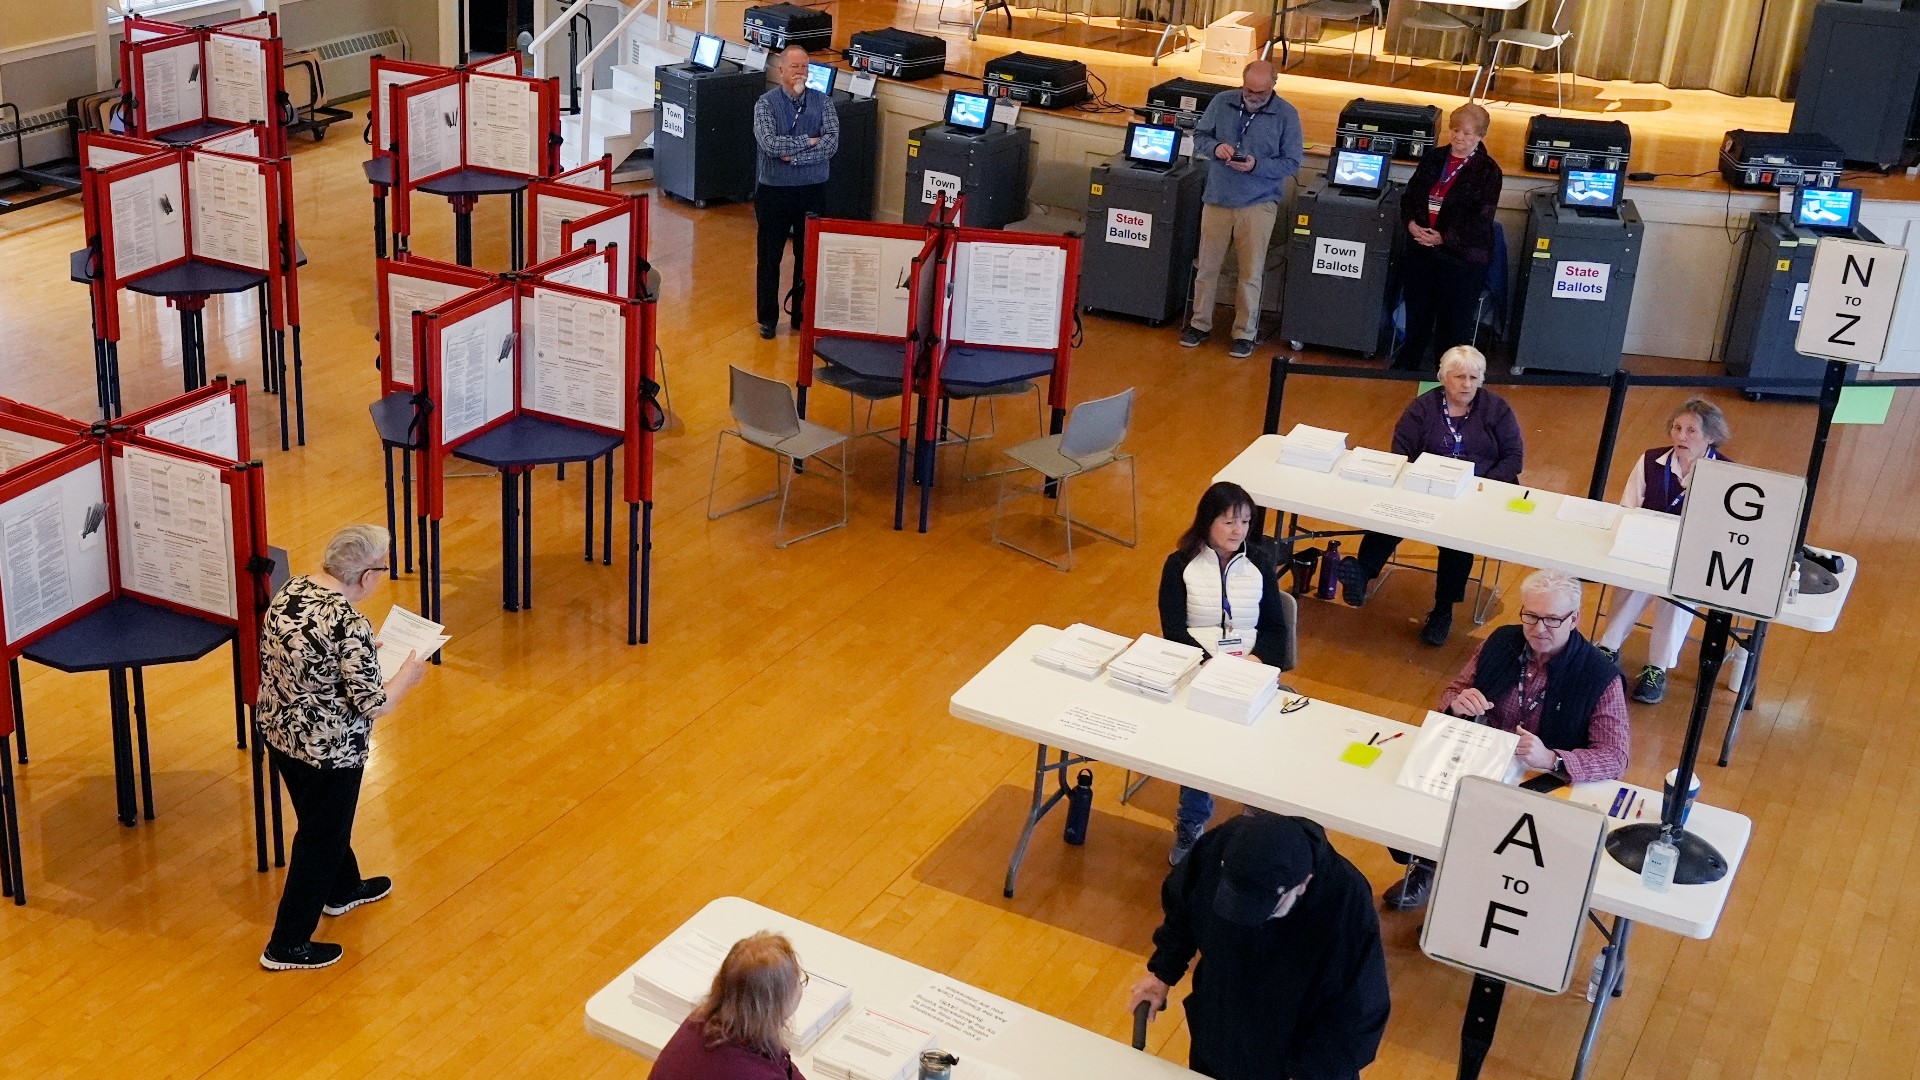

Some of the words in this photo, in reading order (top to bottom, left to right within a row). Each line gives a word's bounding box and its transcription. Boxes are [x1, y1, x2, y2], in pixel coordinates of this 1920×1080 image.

[667, 108, 681, 119] Town
[664, 120, 683, 133] Ballots
[930, 176, 955, 189] Town
[926, 190, 957, 204] Baots
[1116, 214, 1144, 226] State
[1110, 227, 1147, 241] Ballots
[1324, 244, 1356, 257] Town
[1317, 259, 1359, 273] Ballots
[1566, 266, 1599, 277] State
[1841, 254, 1875, 288] N
[1557, 281, 1602, 293] Ballots
[1844, 295, 1862, 306] TO
[1828, 313, 1861, 346] Z
[1724, 482, 1765, 522] G
[1728, 531, 1750, 545] TO
[1706, 550, 1754, 595] M
[1493, 812, 1545, 868] A
[1502, 875, 1530, 894] TO
[1479, 901, 1528, 948] F
